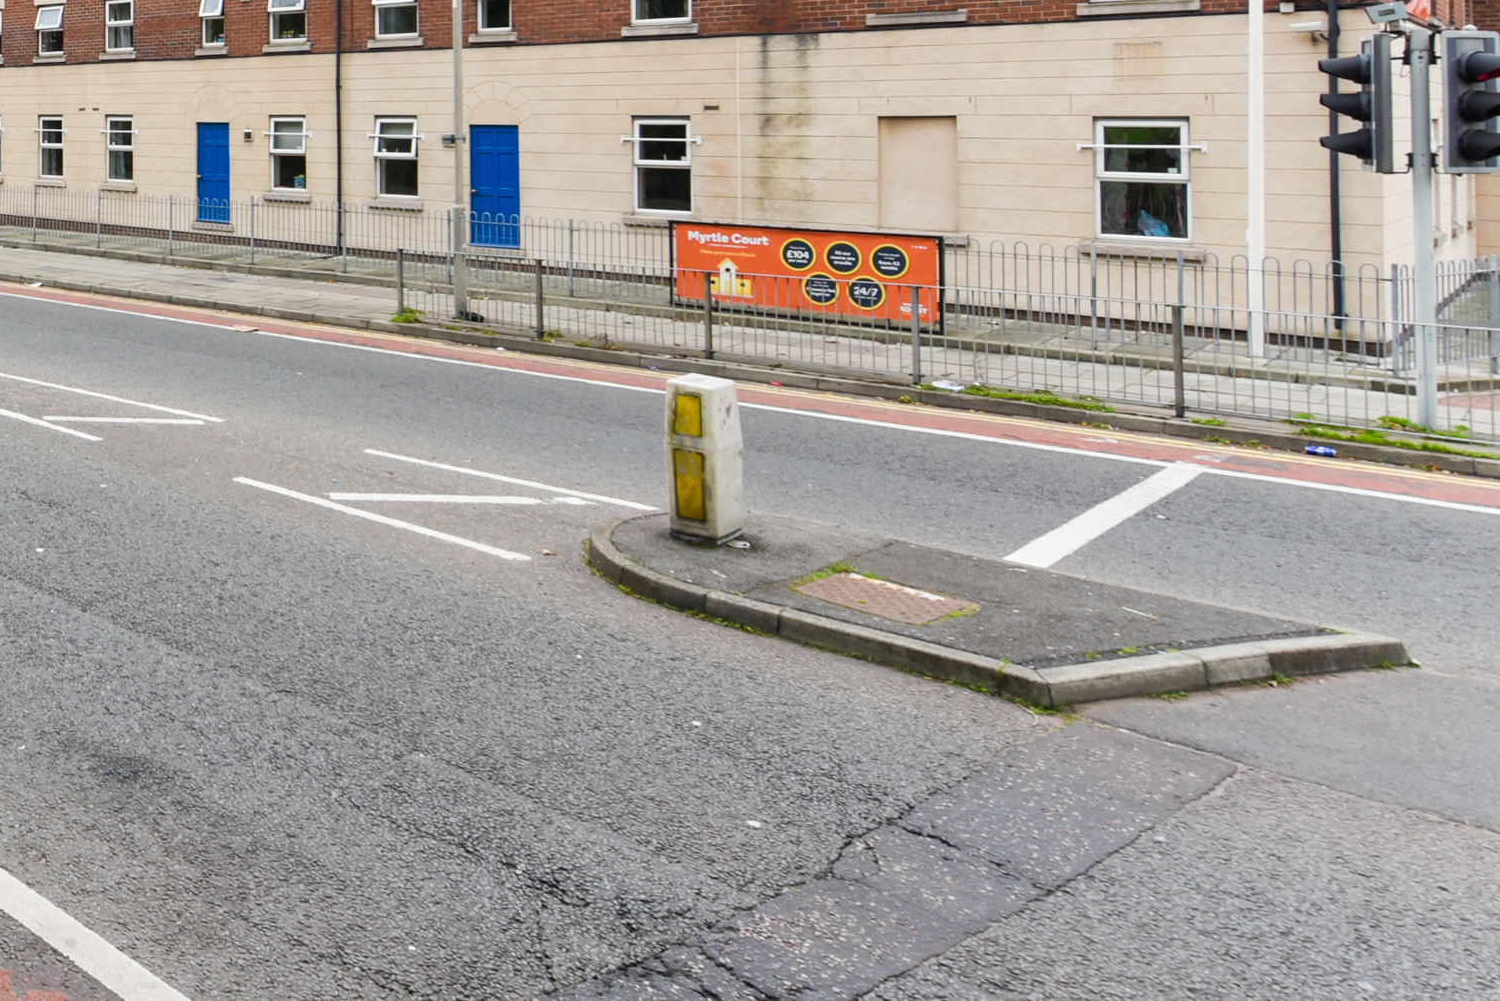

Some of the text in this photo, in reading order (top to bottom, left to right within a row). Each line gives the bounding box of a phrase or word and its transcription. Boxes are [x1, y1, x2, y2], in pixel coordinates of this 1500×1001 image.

[687, 230, 769, 246] Myrtle Court
[786, 250, 810, 259] £104
[853, 286, 878, 296] 24/7
[900, 305, 928, 314] ROST
